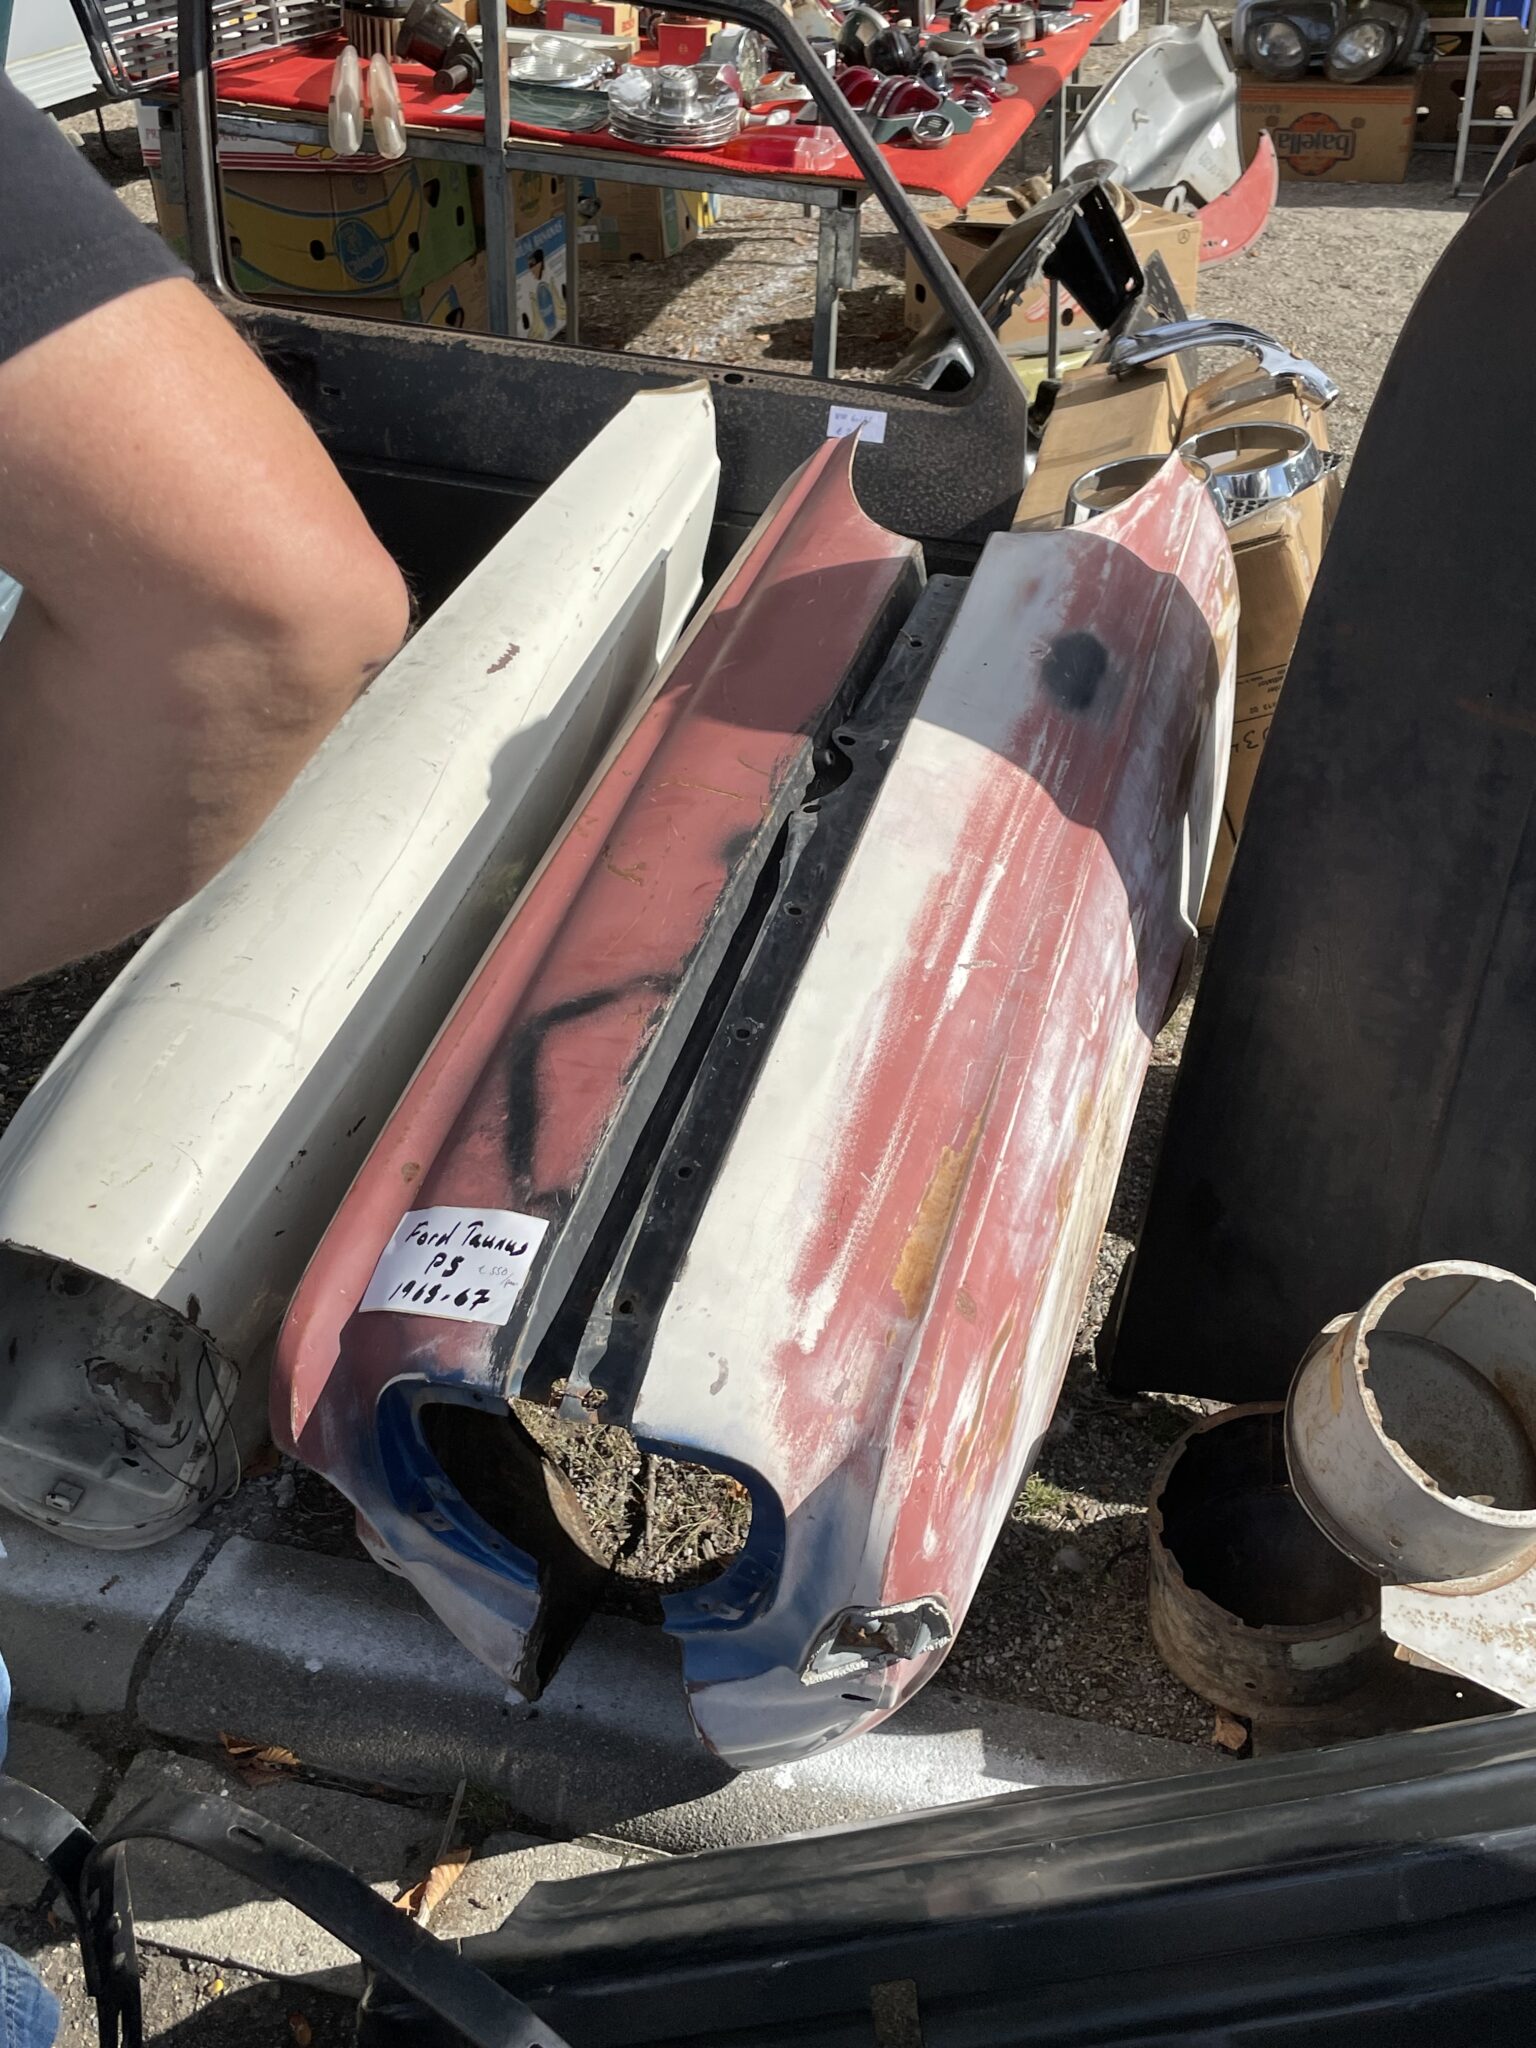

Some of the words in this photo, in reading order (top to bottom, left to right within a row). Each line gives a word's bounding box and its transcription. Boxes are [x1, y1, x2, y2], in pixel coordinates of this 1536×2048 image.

[1277, 129, 1350, 156] bajella
[405, 1221, 461, 1247] Ford
[461, 1221, 528, 1256] Taunus
